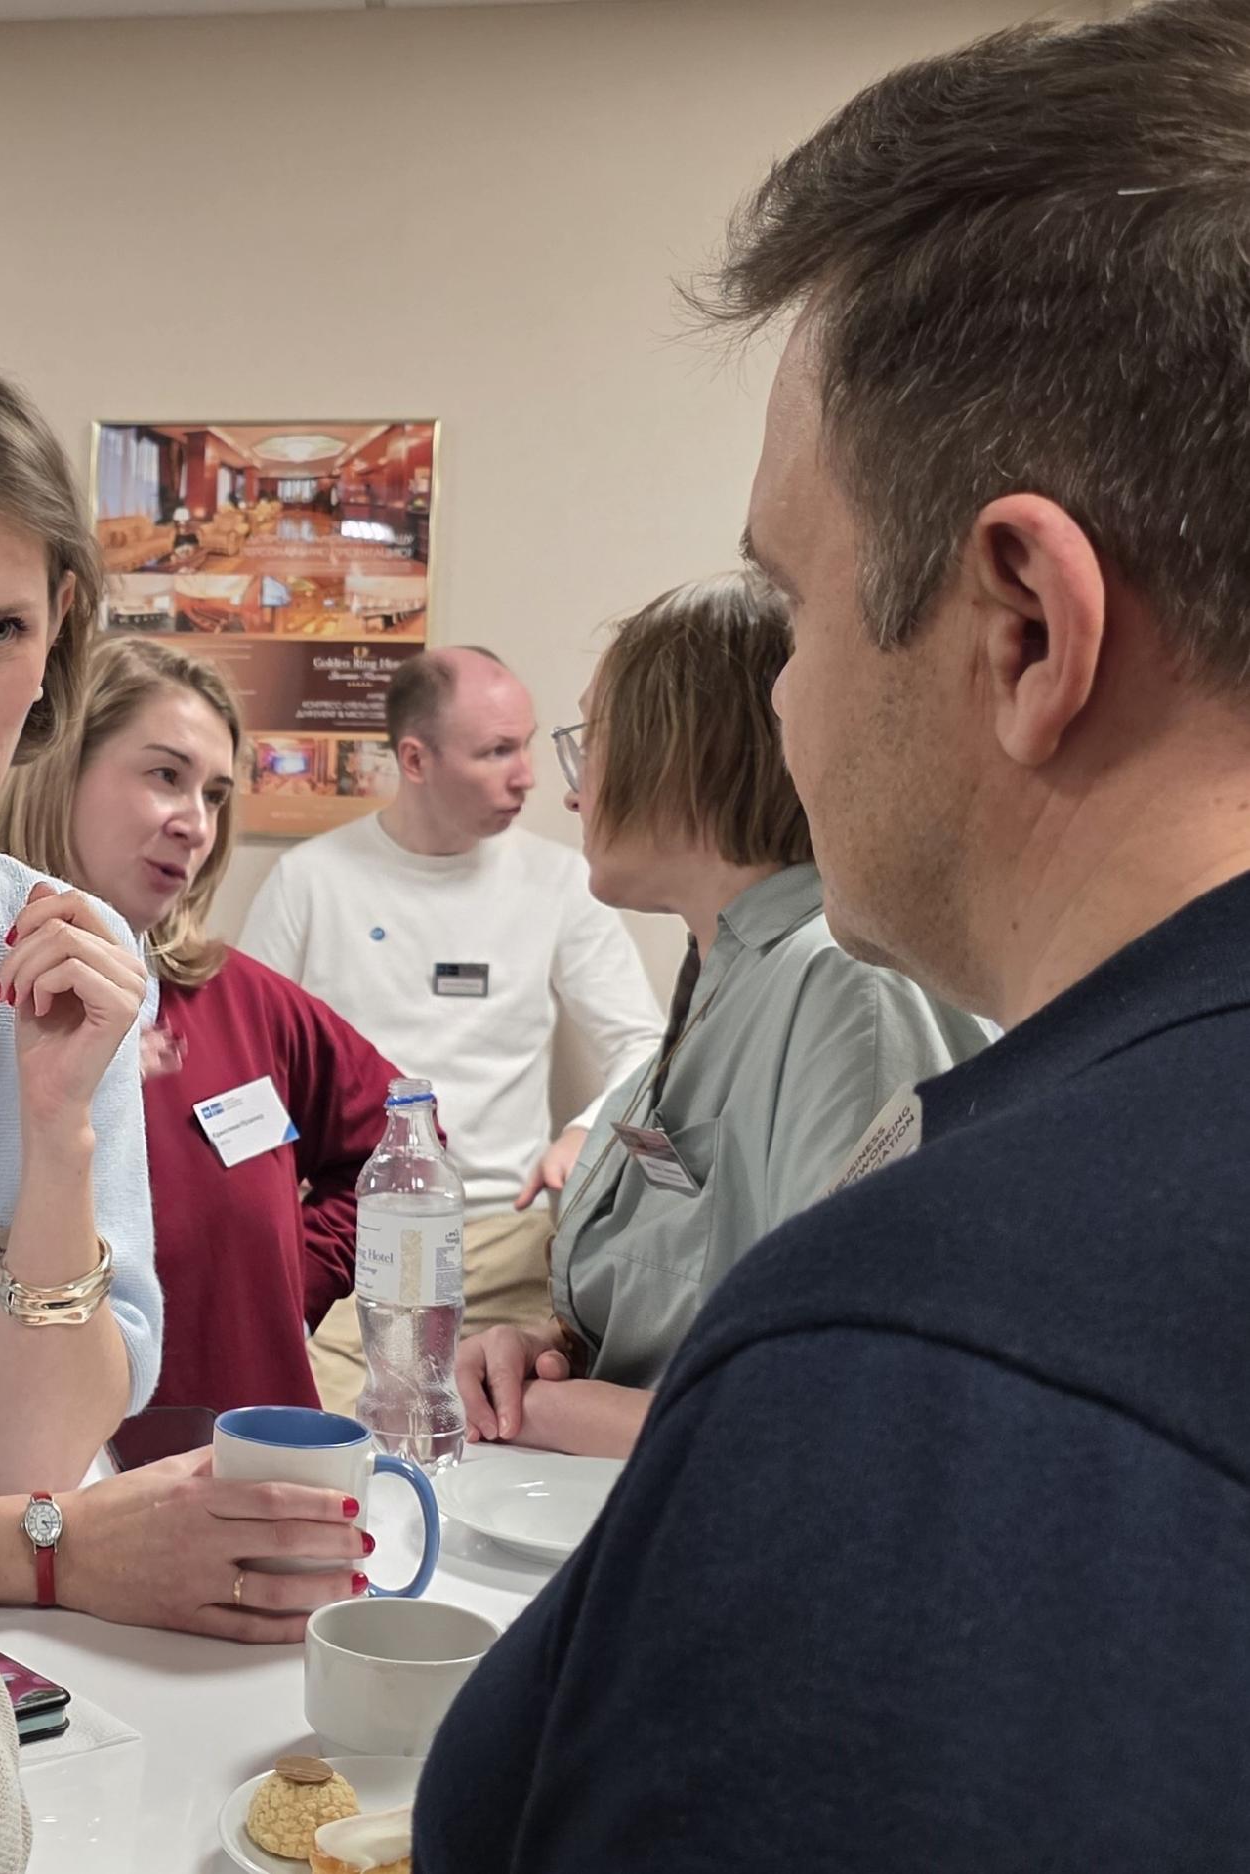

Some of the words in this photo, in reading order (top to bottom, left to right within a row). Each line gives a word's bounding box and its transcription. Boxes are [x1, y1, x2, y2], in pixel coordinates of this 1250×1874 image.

[312, 657, 350, 670] Golden
[353, 658, 377, 671] Ring
[851, 1105, 910, 1182] TWORKING
[871, 1113, 914, 1170] CIATION
[368, 1248, 393, 1264] Hotel
